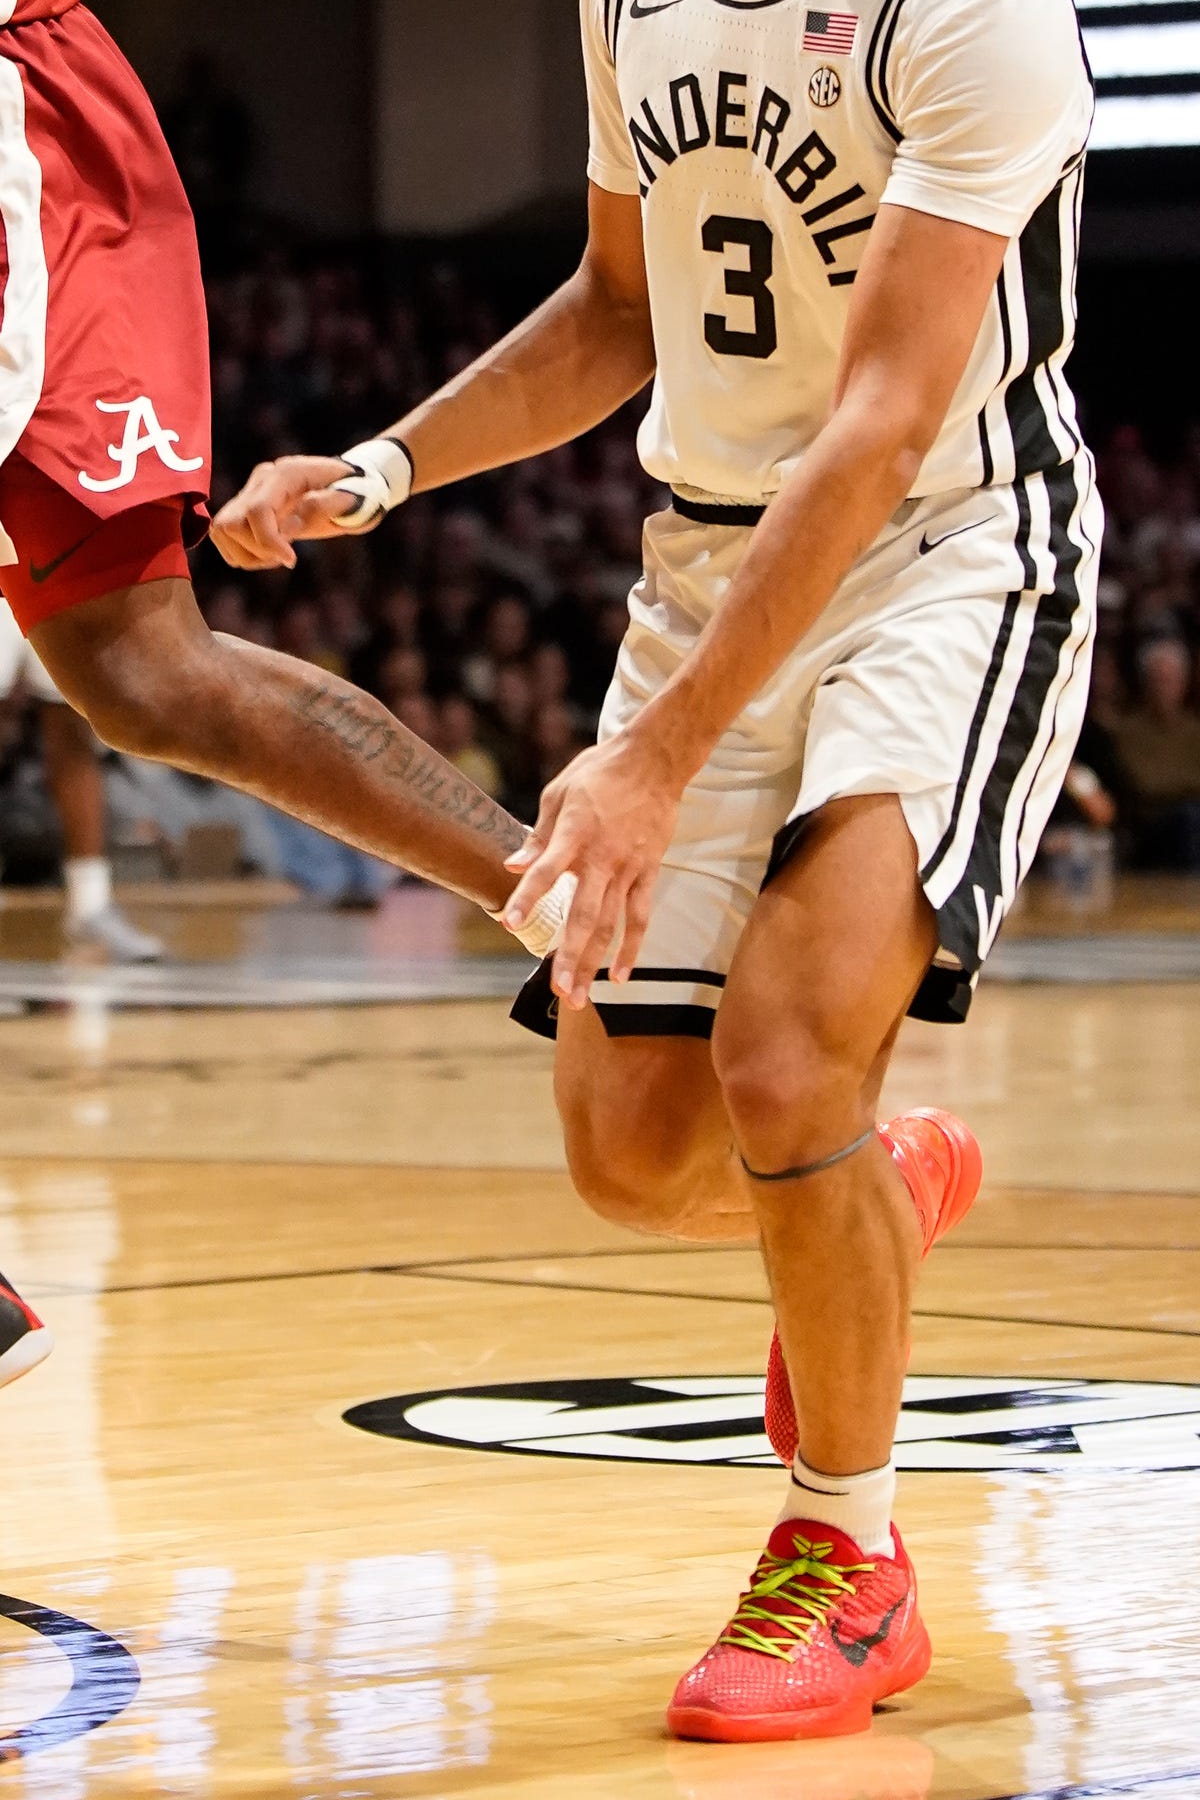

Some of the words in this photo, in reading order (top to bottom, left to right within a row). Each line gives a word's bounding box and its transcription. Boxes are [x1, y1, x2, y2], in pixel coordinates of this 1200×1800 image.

[809, 67, 841, 107] SEC
[629, 70, 876, 287] NDERBIL
[701, 214, 777, 359] 3
[77, 395, 204, 493] A
[972, 884, 1004, 961] V
